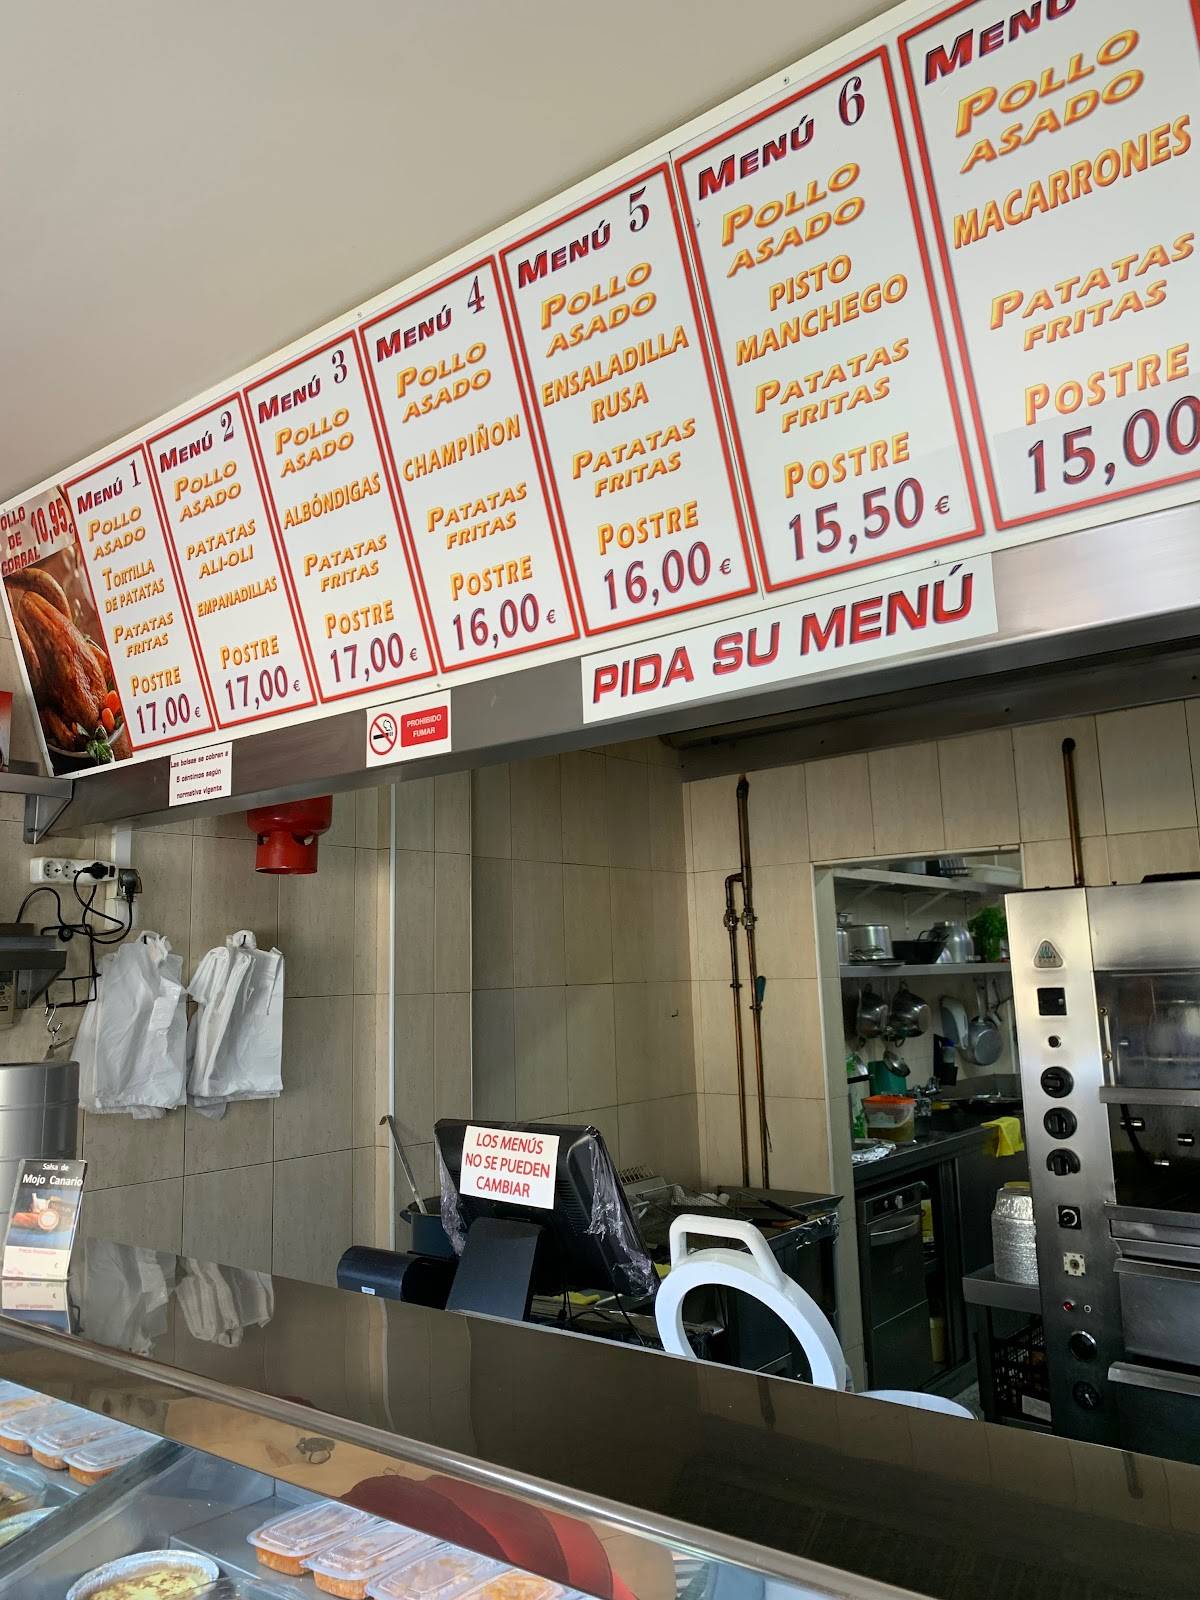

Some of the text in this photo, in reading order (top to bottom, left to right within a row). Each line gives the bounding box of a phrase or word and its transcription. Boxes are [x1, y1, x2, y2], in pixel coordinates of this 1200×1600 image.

[839, 77, 864, 126] 6
[956, 29, 1139, 137] POLLO
[961, 69, 1143, 173] ASADO
[721, 163, 860, 246] POLLO
[953, 115, 1191, 249] MACARRONES
[630, 186, 649, 232] 5
[728, 196, 864, 278] ASADO
[468, 276, 485, 313] 4
[540, 262, 651, 329] POLLO
[769, 255, 852, 311] PISTO
[991, 233, 1194, 329] PATATAS
[546, 292, 656, 358] ASADO
[736, 274, 907, 366] MANCHEGO
[1024, 280, 1167, 351] FRITAS
[331, 349, 348, 384] 3
[396, 342, 486, 399] POLLO
[541, 325, 689, 407] ENSALADILLA
[755, 339, 908, 413] PATATAS
[1024, 343, 1188, 425] POSTRE
[403, 368, 491, 422] ASADO
[591, 382, 649, 423] RUSA
[782, 377, 889, 433] FRITAS
[221, 411, 233, 442] 2
[275, 408, 349, 455] POLLO
[402, 415, 520, 481] CHAMPIÑON
[572, 417, 695, 480] PATATAS
[1029, 396, 1200, 493] 15,00
[130, 460, 141, 486] 1
[281, 432, 353, 477] ASADO
[594, 451, 681, 497] FRITAS
[784, 432, 909, 498] POSTRE
[174, 460, 237, 502] POLLO
[180, 482, 241, 521] ASADO
[283, 473, 381, 529] ALBÓNDIGAS
[0, 506, 25, 531] OLLO
[87, 506, 141, 542] POLLO
[427, 483, 526, 533] PATATAS
[598, 500, 698, 555] POSTRE
[789, 478, 924, 560] 15,50
[8, 531, 22, 550] DE
[94, 526, 145, 560] ASADO
[186, 520, 256, 560] PATATAS
[446, 512, 516, 550] FRITAS
[1, 546, 40, 576] CORRAL
[103, 560, 154, 591] TORTILLA
[200, 545, 254, 578] ALI-OLI
[304, 535, 387, 576] PATATAS
[320, 560, 379, 592] FRITAS
[450, 555, 532, 601] POSTRE
[605, 542, 711, 609] 16,00
[104, 579, 164, 613] DE PATATAS
[196, 576, 277, 618] EMPANADILLAS
[112, 612, 173, 643] PATATAS
[324, 599, 394, 639] POSTRE
[453, 594, 539, 650] 16,00
[592, 563, 974, 704] PIDA SU MENÚ
[126, 633, 168, 657] FRITAS
[220, 635, 279, 669] POSTRE
[331, 633, 404, 682] 17,00
[130, 667, 181, 696] POSTRE
[226, 666, 288, 710] 17,00
[137, 694, 190, 734] 17,00
[406, 714, 441, 727] PROHIBIDO
[412, 727, 435, 737] FUMAR
[205, 752, 224, 761] cobran
[465, 1152, 550, 1178] NO SE PUEDEN
[476, 1133, 544, 1155] LOS MENÚS
[22, 1174, 83, 1186] Mojo Canario
[476, 1175, 531, 1198] CAMBIAR
